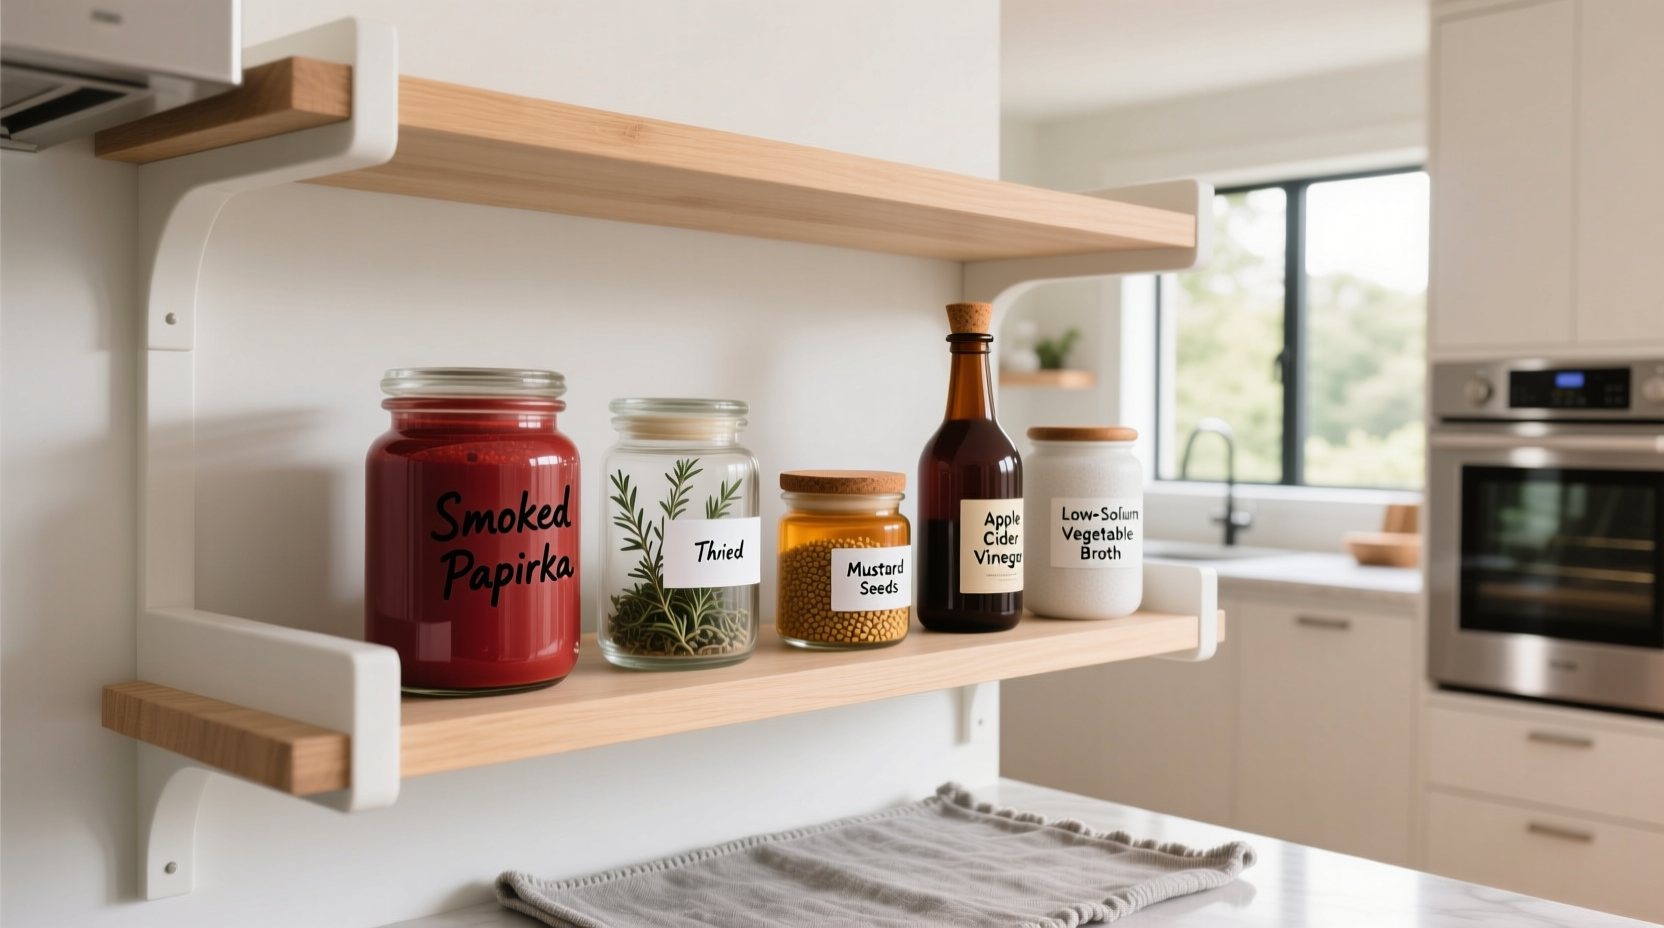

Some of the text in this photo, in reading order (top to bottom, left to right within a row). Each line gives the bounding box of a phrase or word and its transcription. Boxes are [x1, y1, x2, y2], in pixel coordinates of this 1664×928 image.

[431, 485, 571, 541] Smoked
[984, 510, 1020, 531] Apple
[983, 529, 1019, 545] Cider
[1062, 526, 1133, 545] Vegetable
[1080, 545, 1121, 560] Broth
[441, 543, 574, 607] Papirka
[847, 559, 904, 577] Mustard
[860, 579, 898, 596] Seeds
